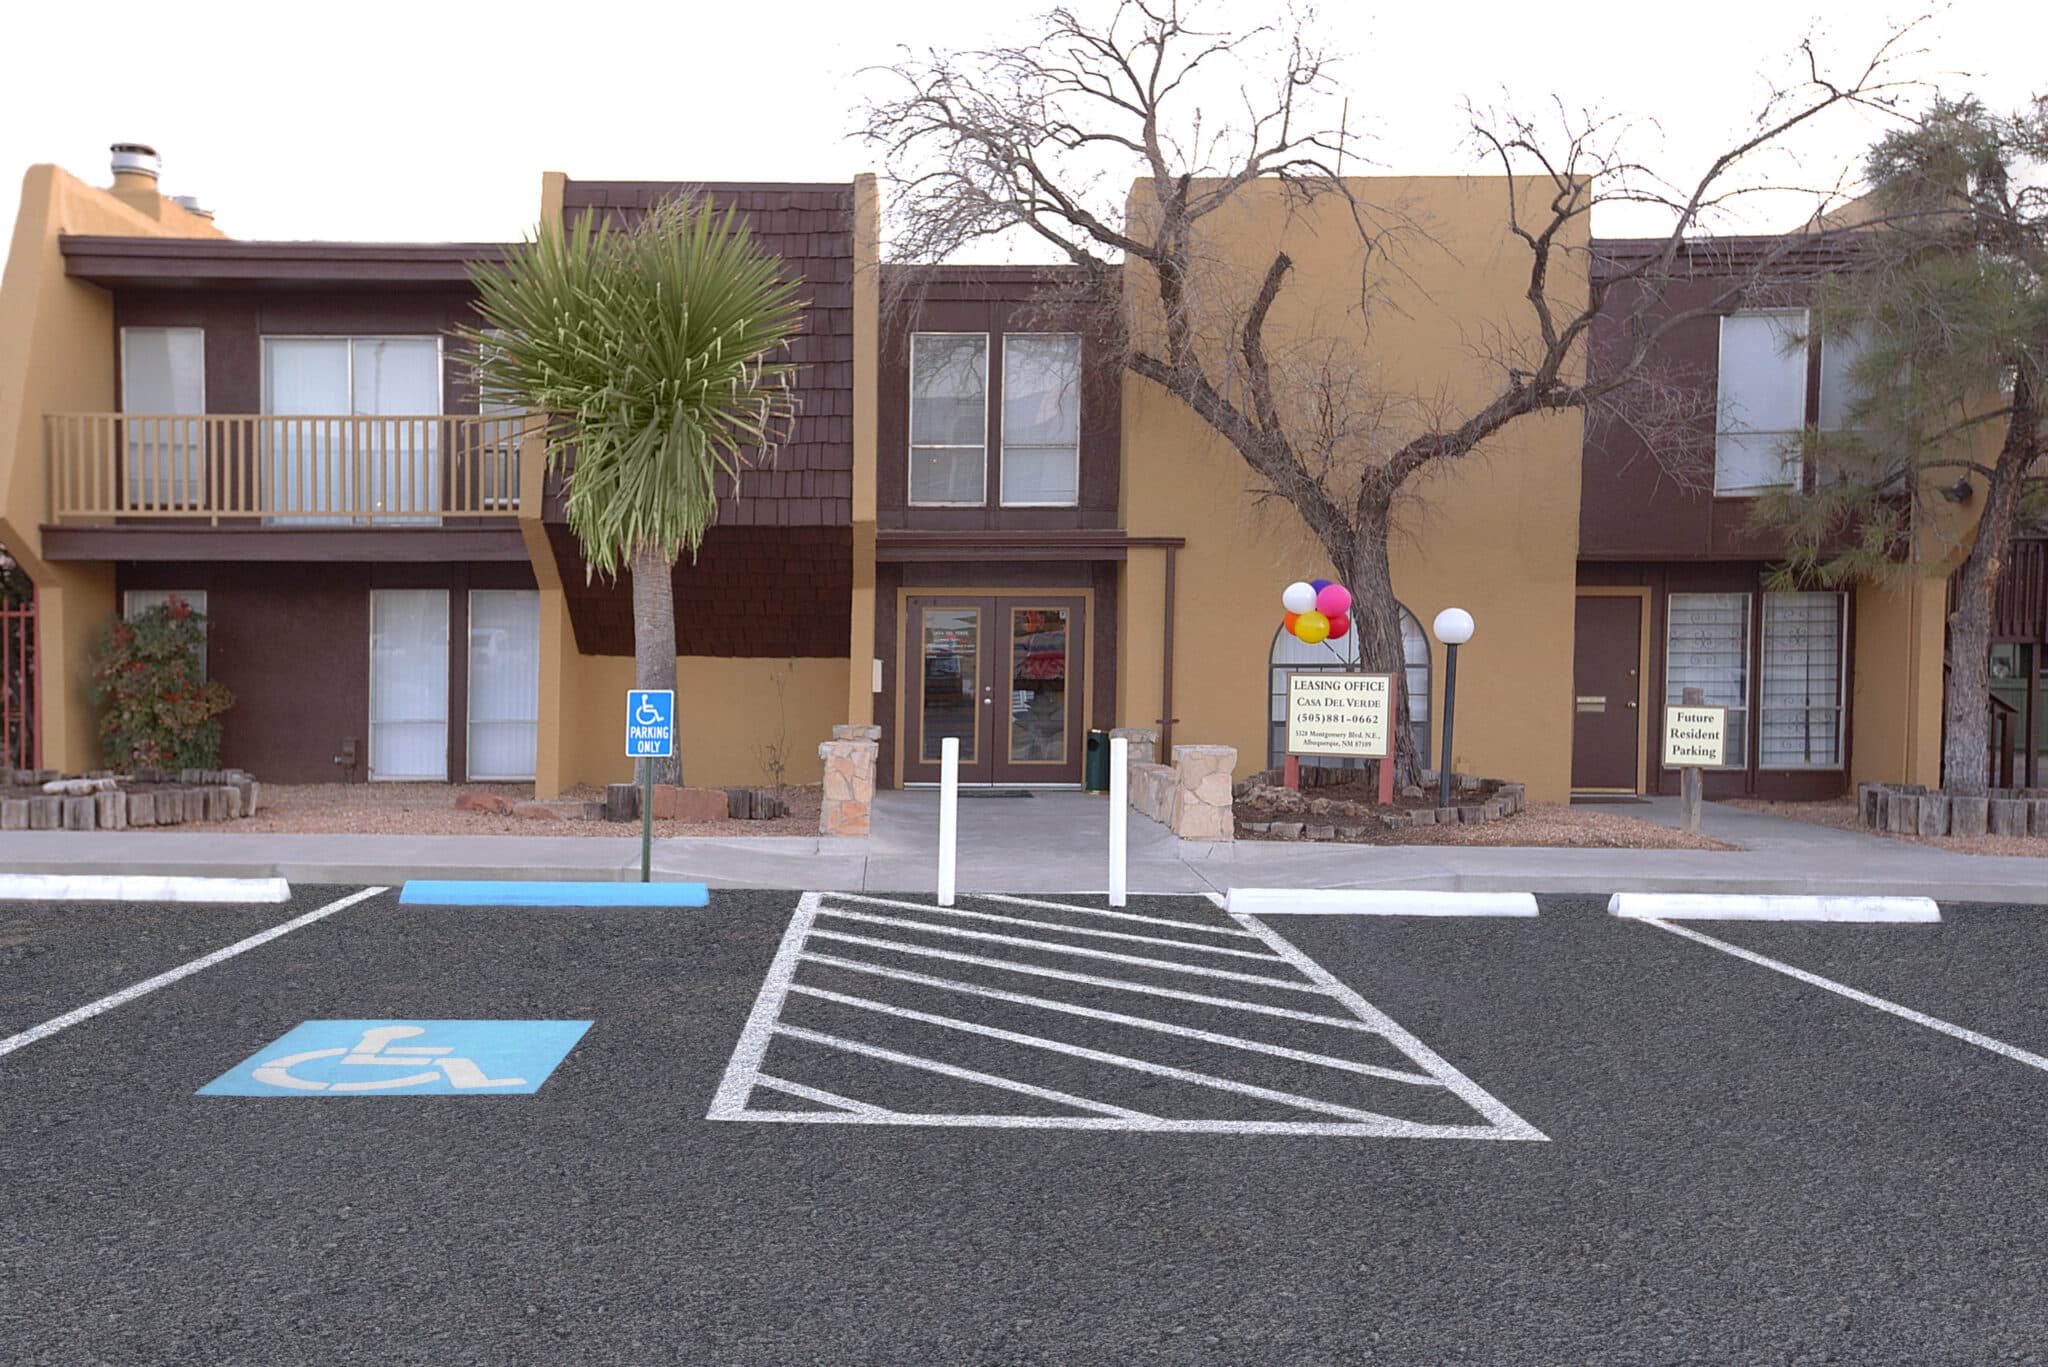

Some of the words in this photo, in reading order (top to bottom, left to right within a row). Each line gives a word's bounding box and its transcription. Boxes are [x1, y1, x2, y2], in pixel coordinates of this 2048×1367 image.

[1294, 680, 1341, 691] LEASING
[1344, 681, 1385, 692] OFFICE
[1297, 697, 1321, 707] CASA
[1324, 697, 1344, 707] DEL
[1346, 698, 1381, 708] VERDE
[1297, 713, 1379, 724] (505)881-0662
[1677, 712, 1714, 722] Future
[630, 726, 669, 739] PARKING
[1310, 730, 1346, 739] Montgomery
[1670, 728, 1719, 739] Resident
[637, 740, 661, 752] ONLY
[1303, 739, 1341, 748] Albuquerque,
[1672, 745, 1717, 759] Parking
